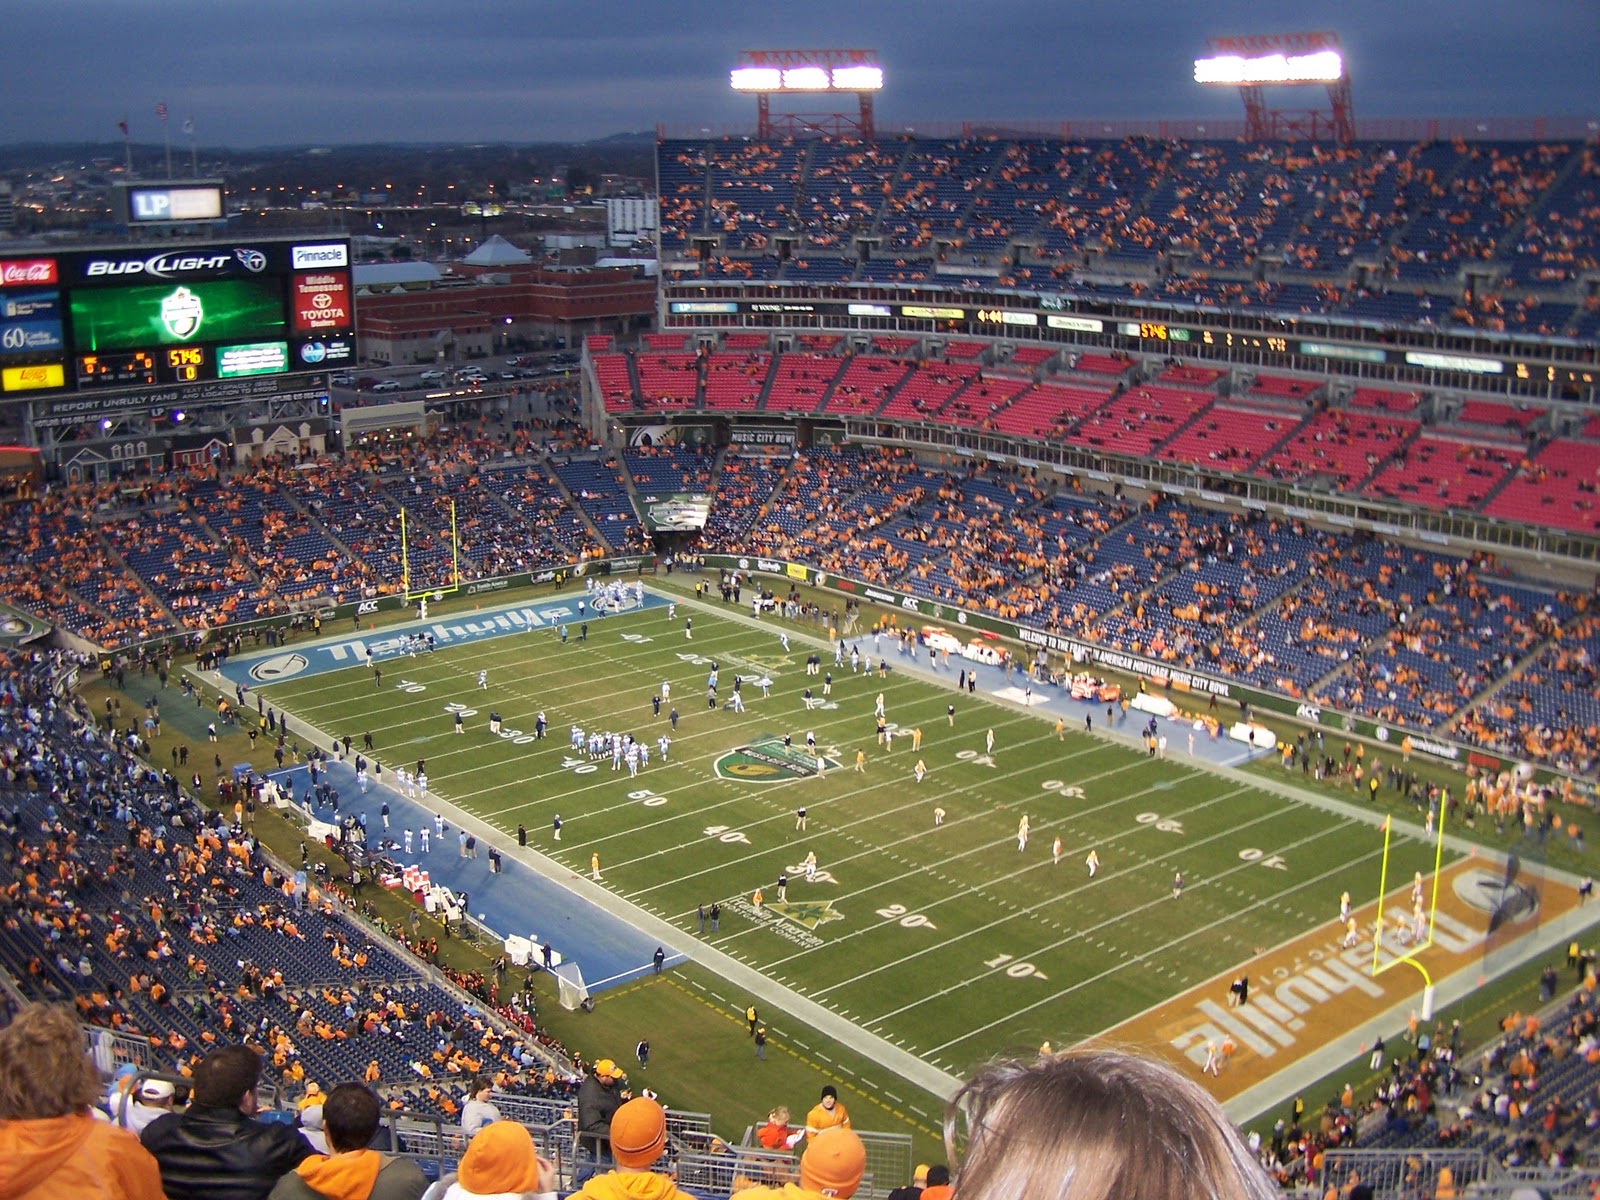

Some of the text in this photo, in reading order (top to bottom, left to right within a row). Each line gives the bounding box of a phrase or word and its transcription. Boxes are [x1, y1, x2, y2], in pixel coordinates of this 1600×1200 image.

[136, 195, 169, 216] LP
[297, 248, 342, 262] Pinnacle
[87, 256, 231, 276] BUD LIGHT
[301, 309, 345, 320] TOYOTA
[3, 327, 25, 348] 60
[53, 392, 178, 413] REPORT UNRULY FANS
[151, 408, 164, 417] LP
[732, 433, 755, 442] MUSIC
[756, 434, 774, 443] CITY
[358, 600, 378, 613] ACC
[902, 596, 919, 611] ACC
[318, 606, 573, 661] Nahville
[1019, 629, 1047, 646] WELCOME
[1048, 635, 1056, 649] TO
[1057, 638, 1069, 653] THE
[1100, 650, 1132, 670] AMERICAN
[1133, 662, 1169, 679] MORTGAGE
[1169, 670, 1192, 685] MUSIC
[1192, 675, 1209, 690] CITY
[1208, 680, 1229, 697] BOWL
[1296, 703, 1320, 722] ACC
[500, 728, 535, 744] 30
[561, 756, 597, 774] 40
[627, 789, 668, 806] 50
[703, 825, 745, 845] 40
[876, 904, 929, 929] 20
[770, 926, 814, 949] COMPANY
[984, 953, 1037, 978] 10
